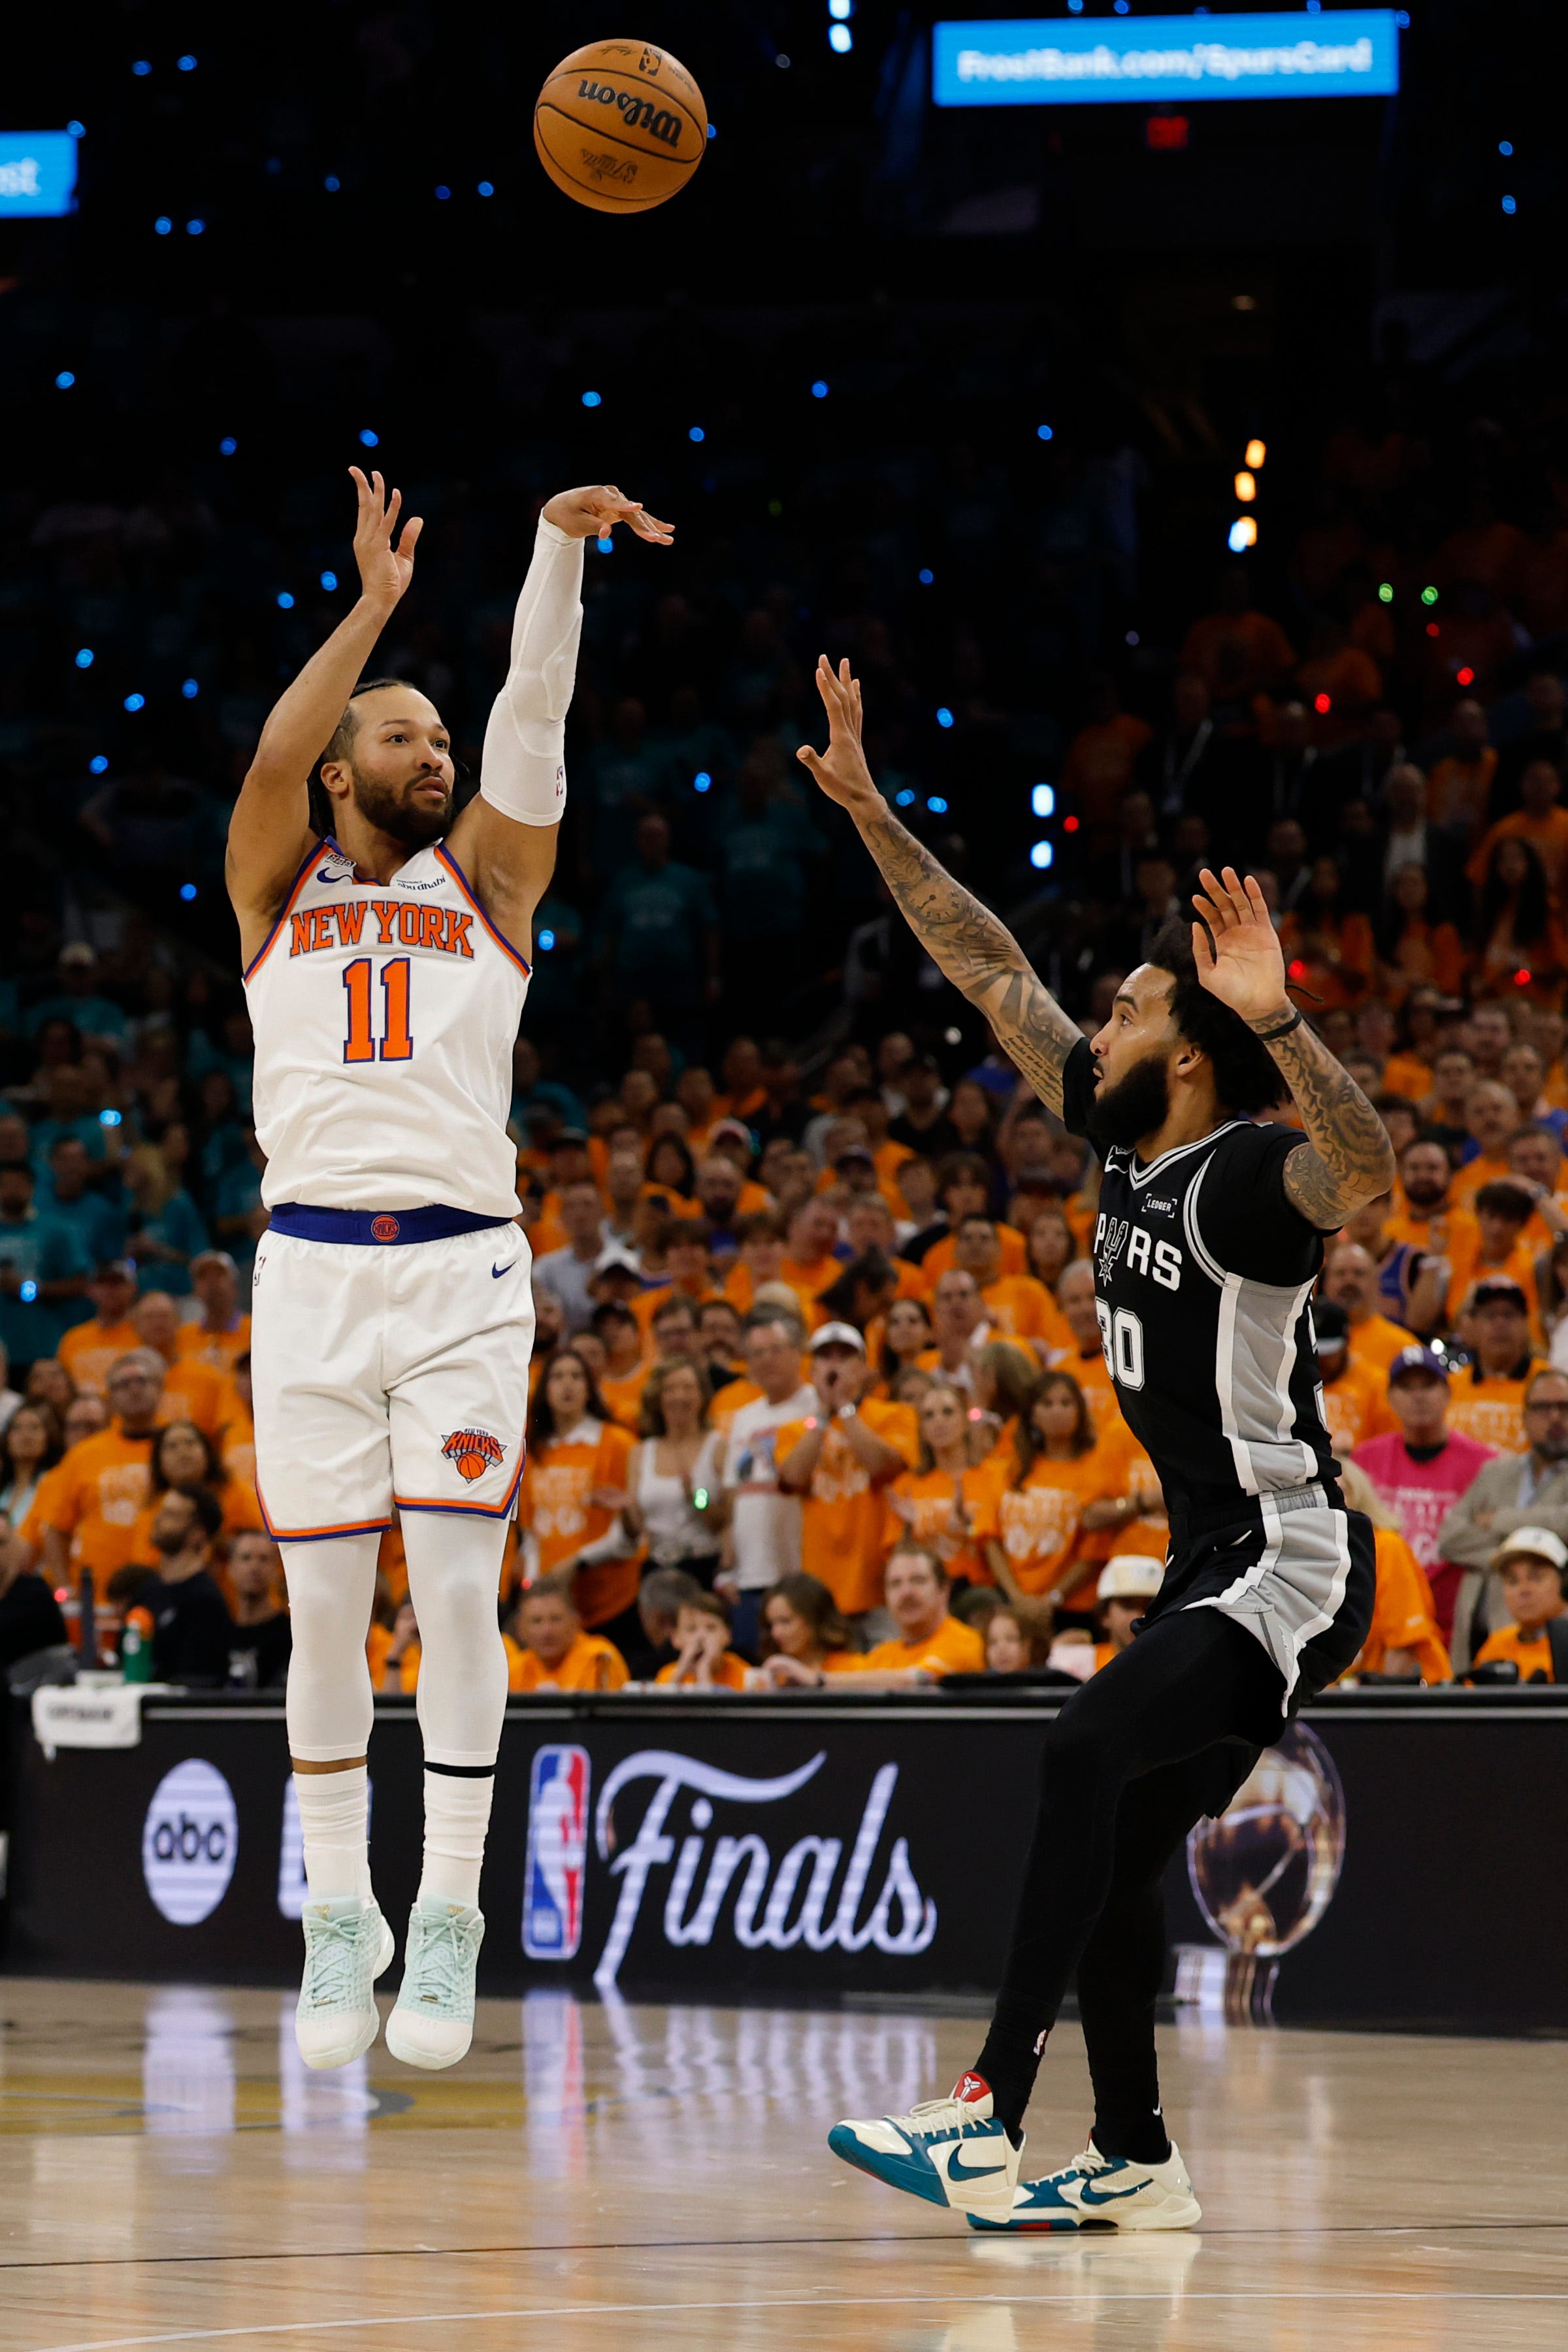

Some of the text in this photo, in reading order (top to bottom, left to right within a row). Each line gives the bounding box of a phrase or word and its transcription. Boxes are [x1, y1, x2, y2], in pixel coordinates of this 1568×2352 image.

[578, 79, 682, 148] Wilson
[417, 874, 446, 890] dhabi
[289, 900, 475, 961] NEW YORK
[342, 957, 413, 1064] 11
[1147, 1199, 1171, 1212] LEDGER
[441, 1431, 504, 1462] KNICKS
[476, 1429, 489, 1437] YORK
[153, 1812, 226, 1861] abc
[593, 1750, 937, 1986] Finals
